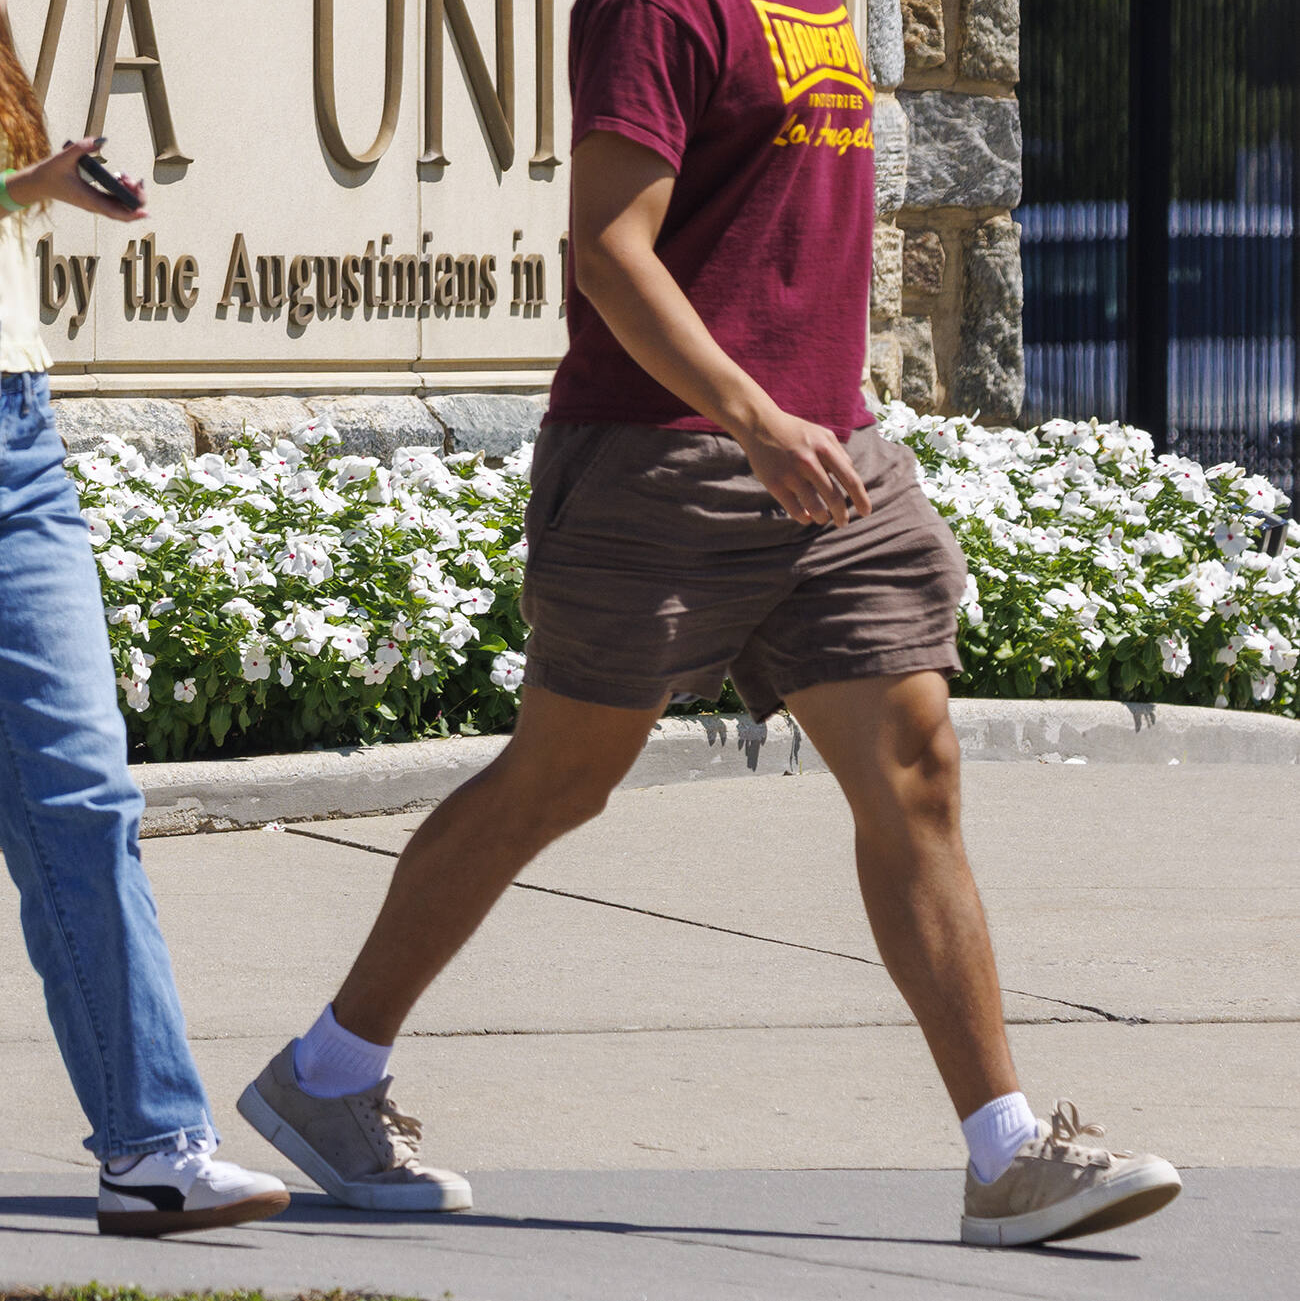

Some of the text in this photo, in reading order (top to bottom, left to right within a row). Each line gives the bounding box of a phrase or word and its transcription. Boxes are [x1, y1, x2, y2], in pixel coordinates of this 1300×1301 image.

[814, 111, 875, 157] Angel
[37, 231, 101, 327] by
[120, 231, 199, 310] the
[216, 232, 498, 326] Augustinians
[510, 229, 549, 306] in
